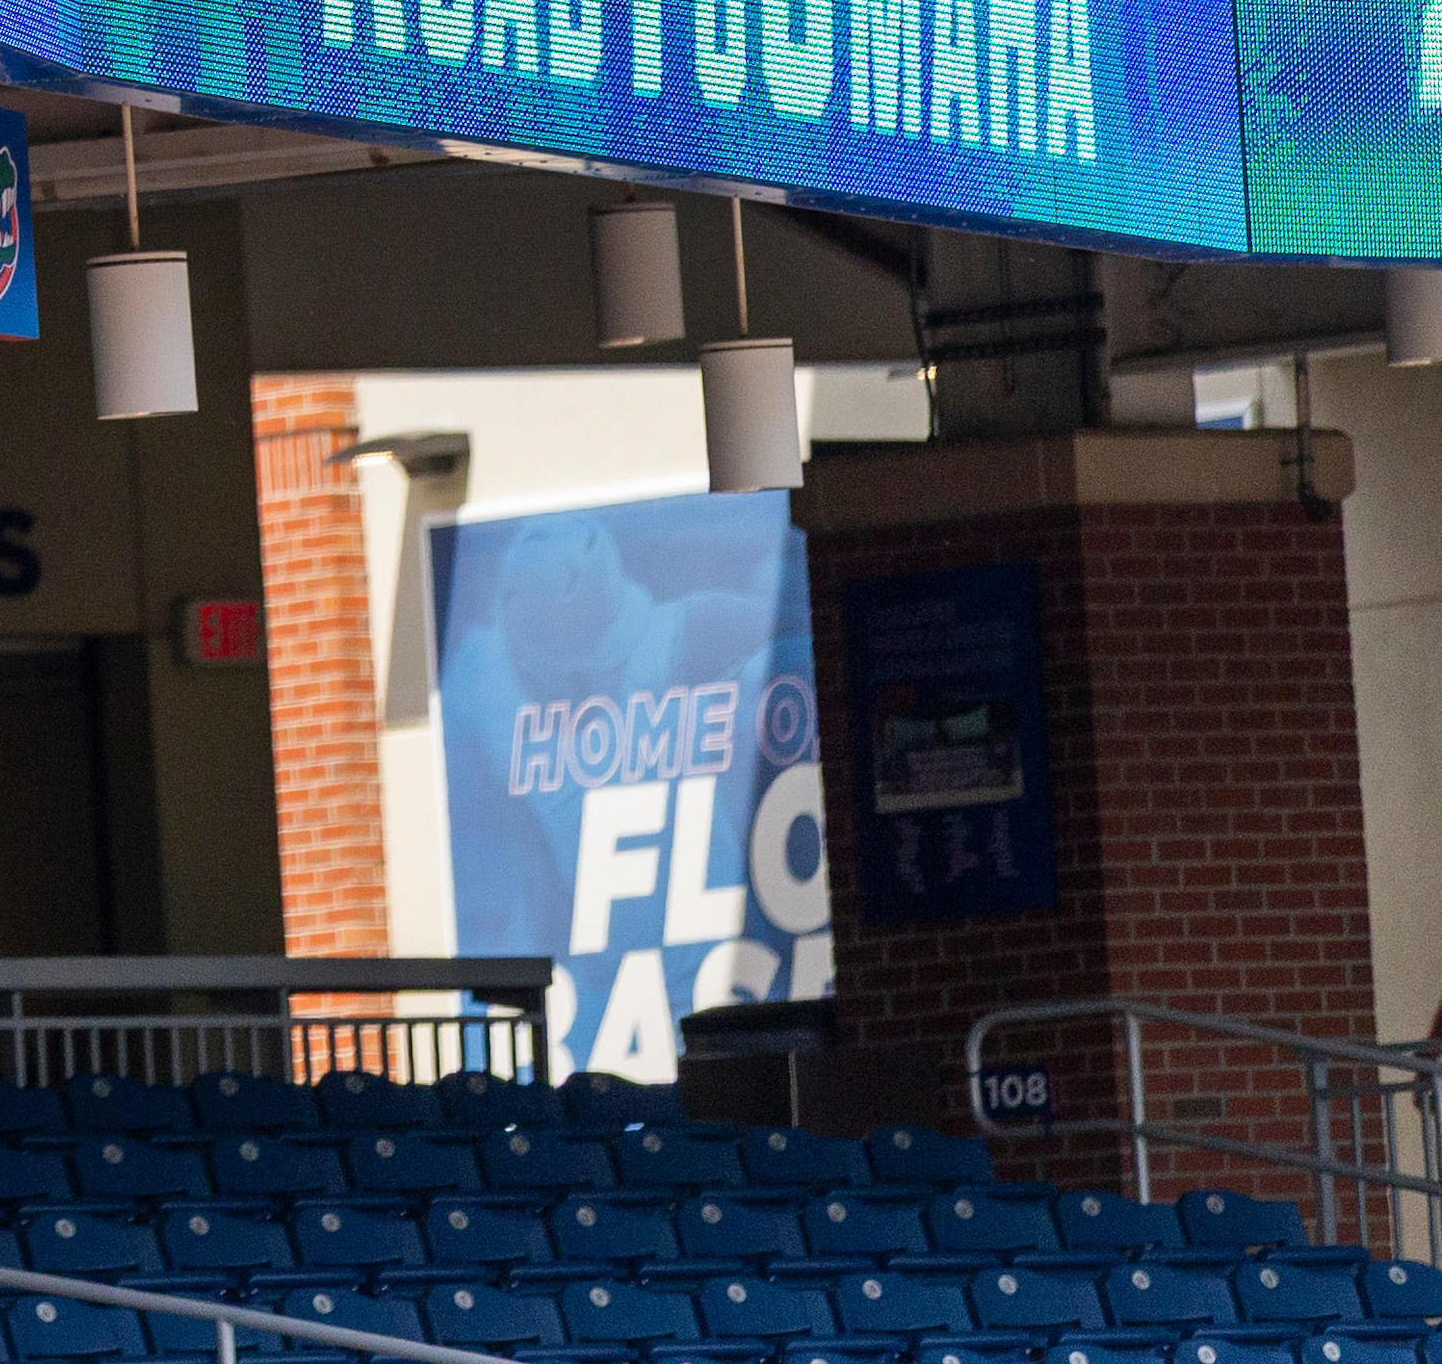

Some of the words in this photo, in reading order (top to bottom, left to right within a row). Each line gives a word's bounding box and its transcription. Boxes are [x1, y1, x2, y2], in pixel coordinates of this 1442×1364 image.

[508, 681, 739, 795] HOME
[757, 674, 817, 767] O
[984, 1072, 1048, 1110] 108
